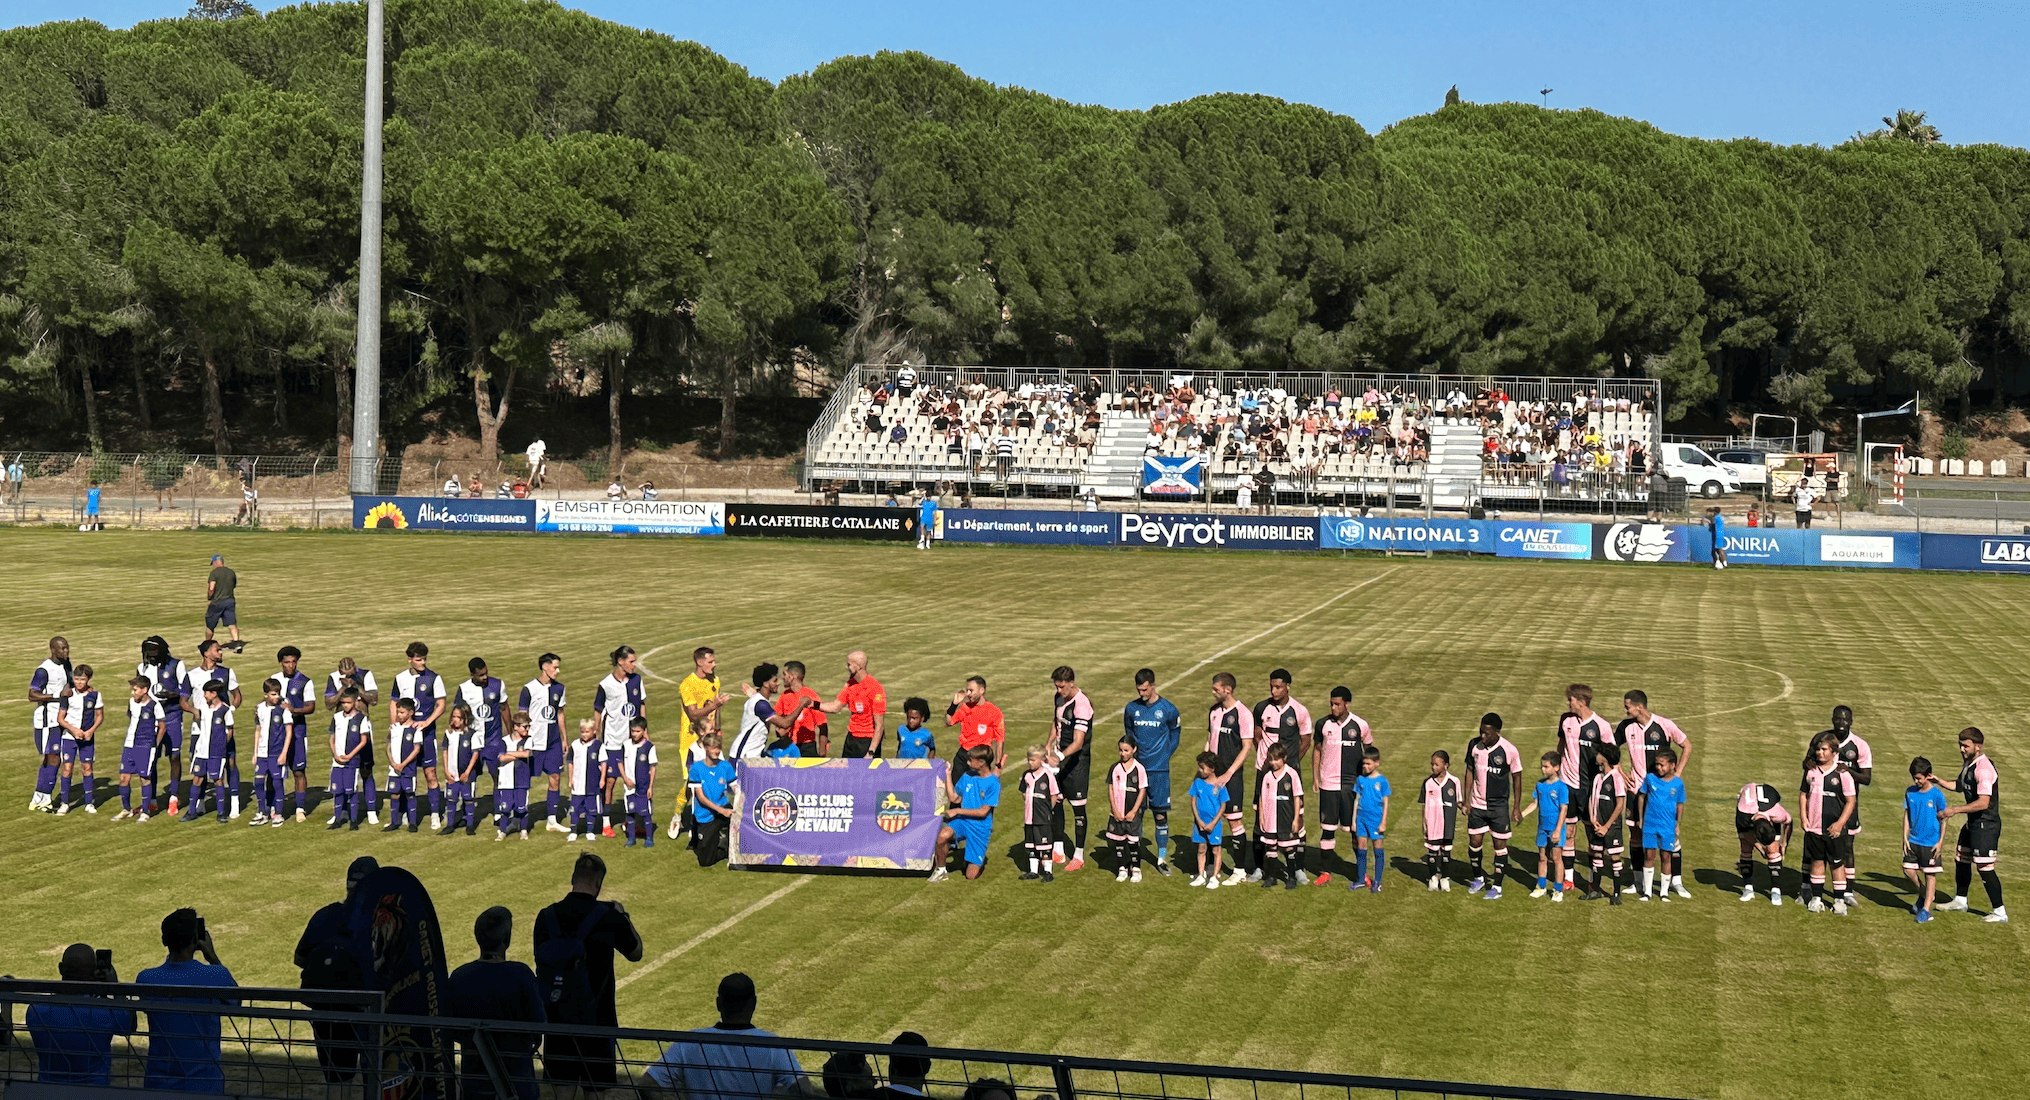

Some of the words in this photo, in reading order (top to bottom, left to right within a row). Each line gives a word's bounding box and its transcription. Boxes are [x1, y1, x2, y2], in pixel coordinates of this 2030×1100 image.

[555, 501, 609, 514] EMSAT
[613, 503, 706, 515] FORMATION
[740, 515, 757, 526] LA
[759, 515, 830, 528] CAFETIERE
[832, 517, 900, 530] CATALANE
[948, 519, 960, 529] Le
[963, 519, 1034, 533] Département,
[1036, 522, 1063, 532] terre
[1065, 522, 1078, 532] de
[1080, 523, 1108, 534] sport
[1121, 514, 1226, 547] Peyrot
[1230, 524, 1314, 541] IMMOBILIER
[1369, 527, 1465, 542] NATIONAL
[1468, 528, 1480, 543] 3
[1500, 528, 1562, 543] CANET
[1832, 551, 1883, 559] AQUARIUM
[797, 794, 819, 807] LES
[820, 794, 854, 807] CLUBS
[797, 807, 854, 818] CHRISTOPHE
[795, 818, 853, 832] REVAULT
